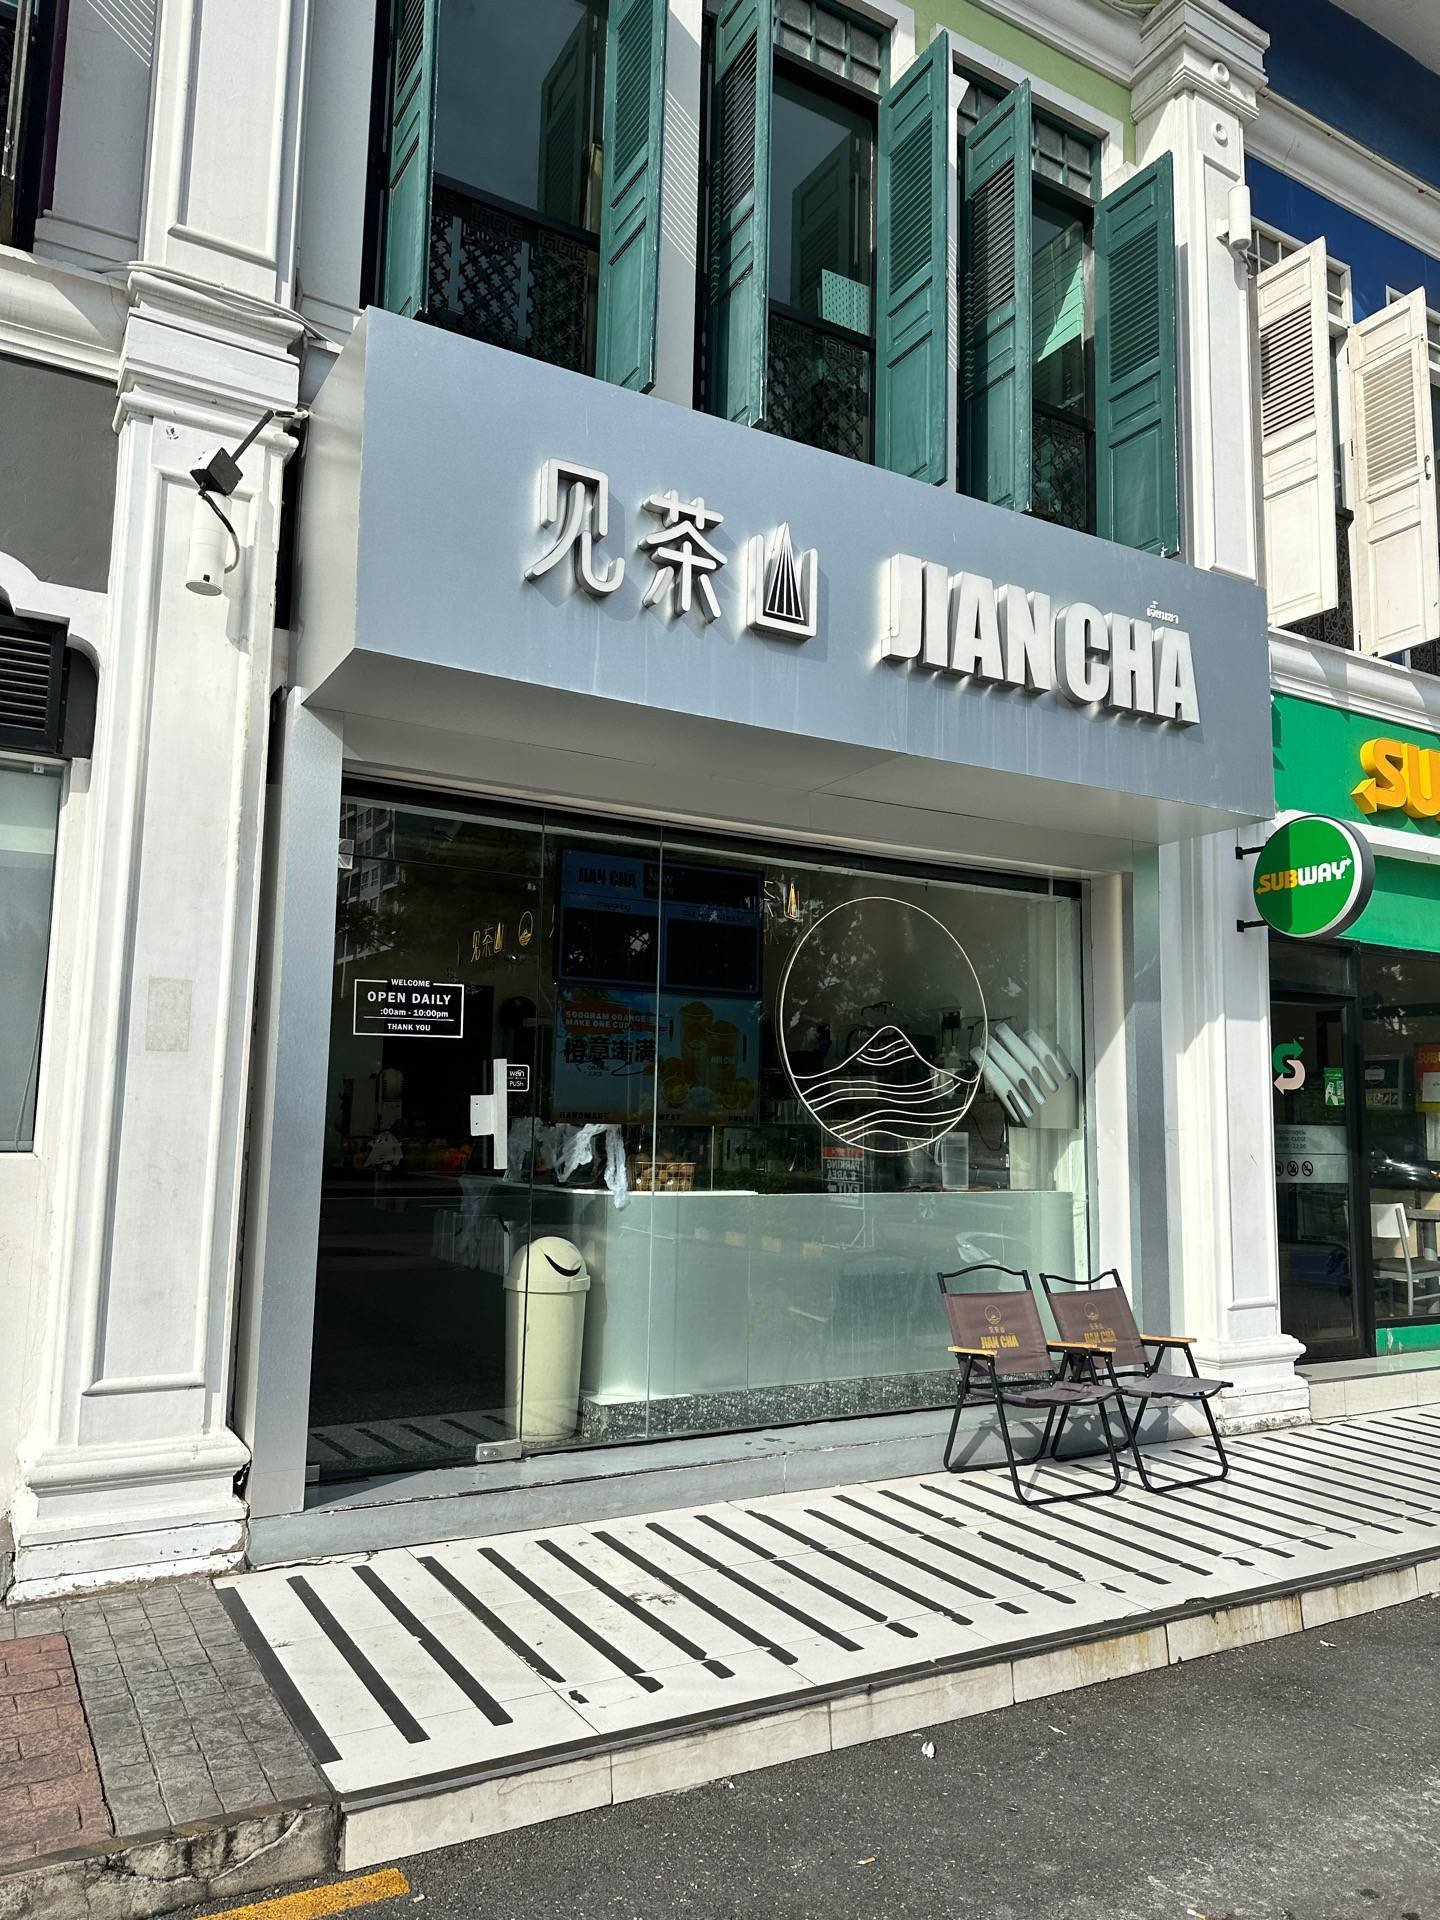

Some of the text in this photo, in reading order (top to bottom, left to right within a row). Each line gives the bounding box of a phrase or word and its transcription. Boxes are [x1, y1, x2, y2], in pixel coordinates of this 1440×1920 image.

[524, 457, 818, 640] 见茶山
[1350, 737, 1440, 819] SU
[1255, 855, 1353, 895] SUBWAY
[391, 978, 430, 988] WELCOME
[367, 991, 452, 1006] OPEN DAILY
[380, 1007, 406, 1016] :00am
[413, 1009, 449, 1019] 10:00pm
[387, 1023, 431, 1032] THANK YOU
[565, 1018, 630, 1030] MAKE ONE CUP
